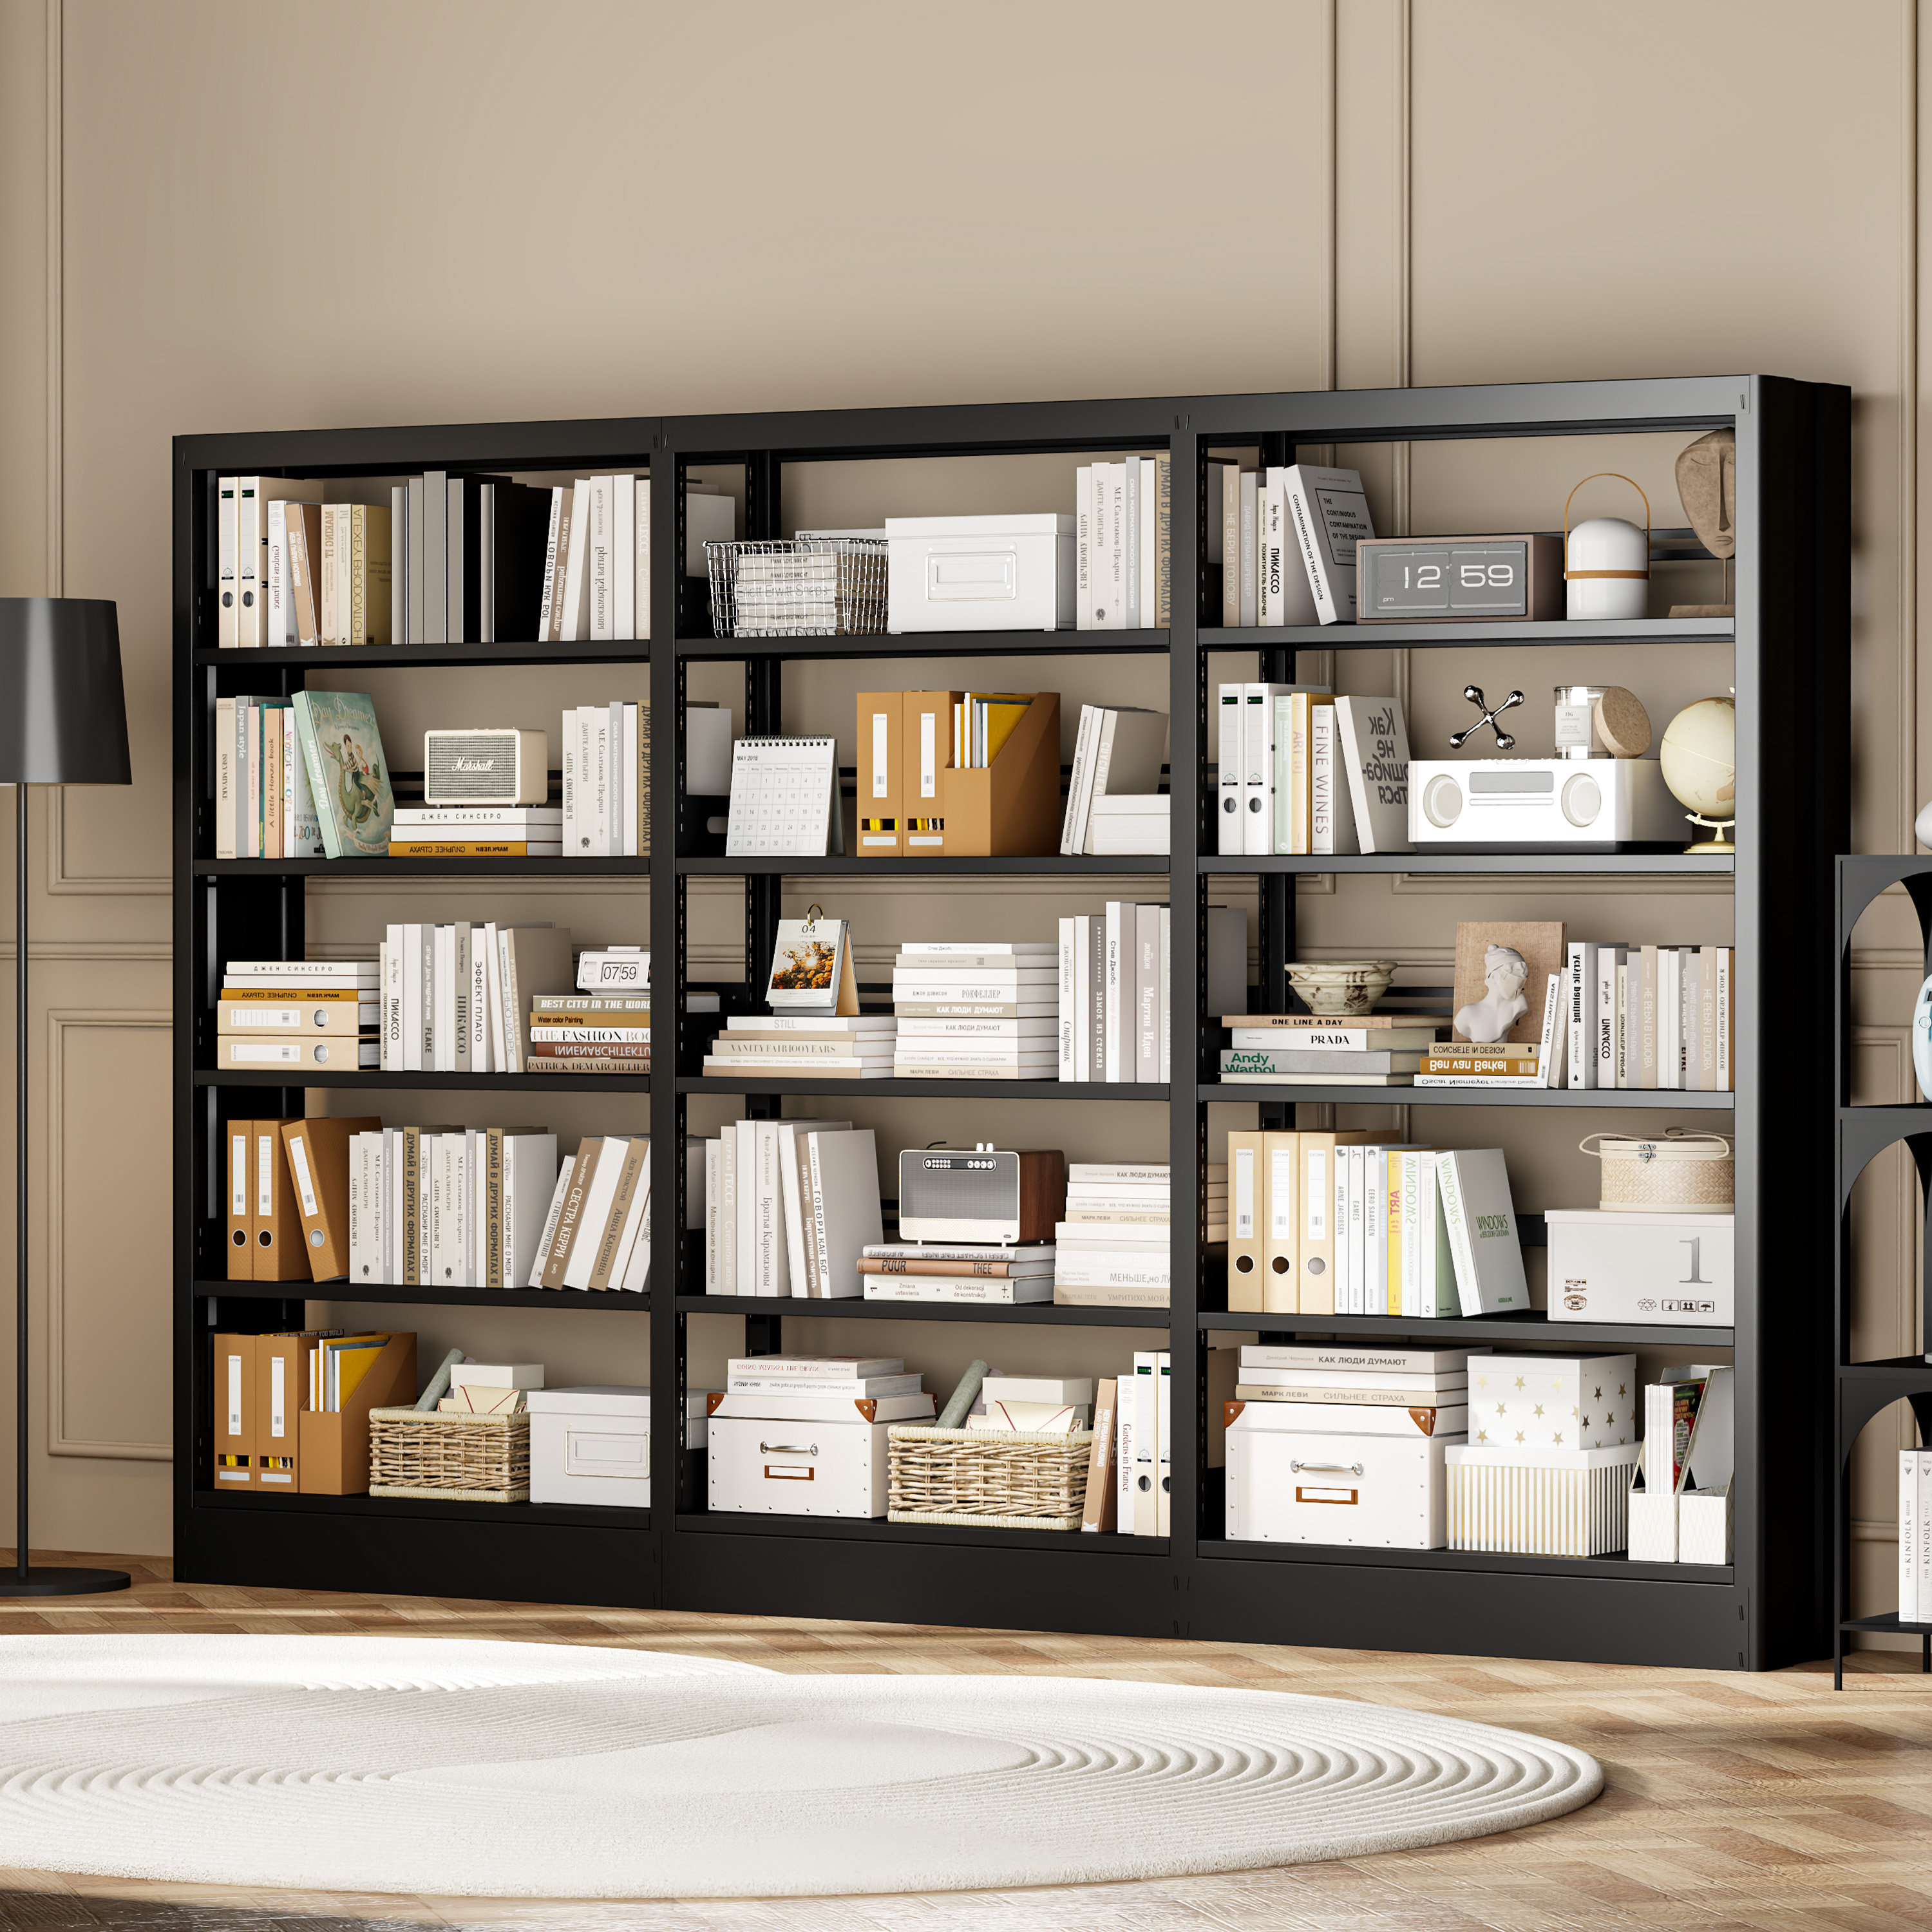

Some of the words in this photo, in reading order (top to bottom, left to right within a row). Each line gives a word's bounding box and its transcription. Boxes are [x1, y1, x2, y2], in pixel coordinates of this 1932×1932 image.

[1293, 495, 1311, 549] CONTAMINATION
[1326, 509, 1356, 518] CONTINUOUS
[1329, 521, 1367, 530] CONTAMINATION
[1271, 549, 1280, 594] ПИКАССО
[1309, 561, 1318, 573] THE
[1404, 565, 1441, 589] 12
[1461, 564, 1514, 588] 59
[1312, 576, 1323, 600] DESIGN
[1383, 595, 1396, 603] pm
[238, 705, 247, 733] Japan
[238, 735, 247, 759] style
[1315, 726, 1329, 766] FINE
[451, 756, 495, 771] Marshall
[1315, 774, 1329, 834] WINES
[802, 925, 816, 933] 04
[603, 966, 620, 980] 07
[620, 966, 637, 980] 59
[540, 999, 565, 1009] BEST
[567, 999, 589, 1009] CITY
[603, 1000, 623, 1009] THE
[952, 1007, 972, 1015] ЛЮДИ
[974, 1007, 1004, 1015] ДУМАЮТ
[1142, 987, 1154, 1026] Мартин
[391, 998, 399, 1041] ПИКАССО
[457, 996, 466, 1054] ПИКАССО
[567, 1016, 583, 1025] Painting
[774, 1019, 797, 1029] STILL
[1061, 1021, 1072, 1062] Спартак
[1142, 1032, 1154, 1058] Иден
[1311, 1035, 1350, 1045] PRADA
[528, 1061, 569, 1071] PATRICK
[572, 1062, 650, 1072] DEMARCHELIER
[1225, 1064, 1276, 1073] Warhol
[1231, 1052, 1269, 1066] Andy
[406, 1133, 417, 1167] ДУМАЙ
[1441, 1157, 1461, 1225] WINDOWS
[563, 1188, 583, 1224] СЕСТРА
[760, 1197, 773, 1229] Братья
[814, 1191, 824, 1234] ГОВОРИ
[540, 1201, 562, 1258] СТИХОТВОРЕНИЯ
[1475, 1214, 1508, 1231] WINDOWS
[553, 1226, 573, 1258] КЕРРИ
[760, 1231, 773, 1287] Карамазовы
[882, 1260, 907, 1273] PUUR
[972, 1263, 992, 1274] THEE
[1679, 1236, 1712, 1283] 1
[1338, 1357, 1365, 1365] ЛЮДИ
[1367, 1358, 1407, 1367] ДУМАЮТ
[1323, 1392, 1367, 1401] СИЛЬНЕЕ
[1371, 1394, 1405, 1402] СТРАХА
[1102, 1409, 1111, 1422] NEW
[1122, 1424, 1132, 1454] Gardens
[1097, 1442, 1107, 1467] HOUSING
[1122, 1466, 1132, 1492] France
